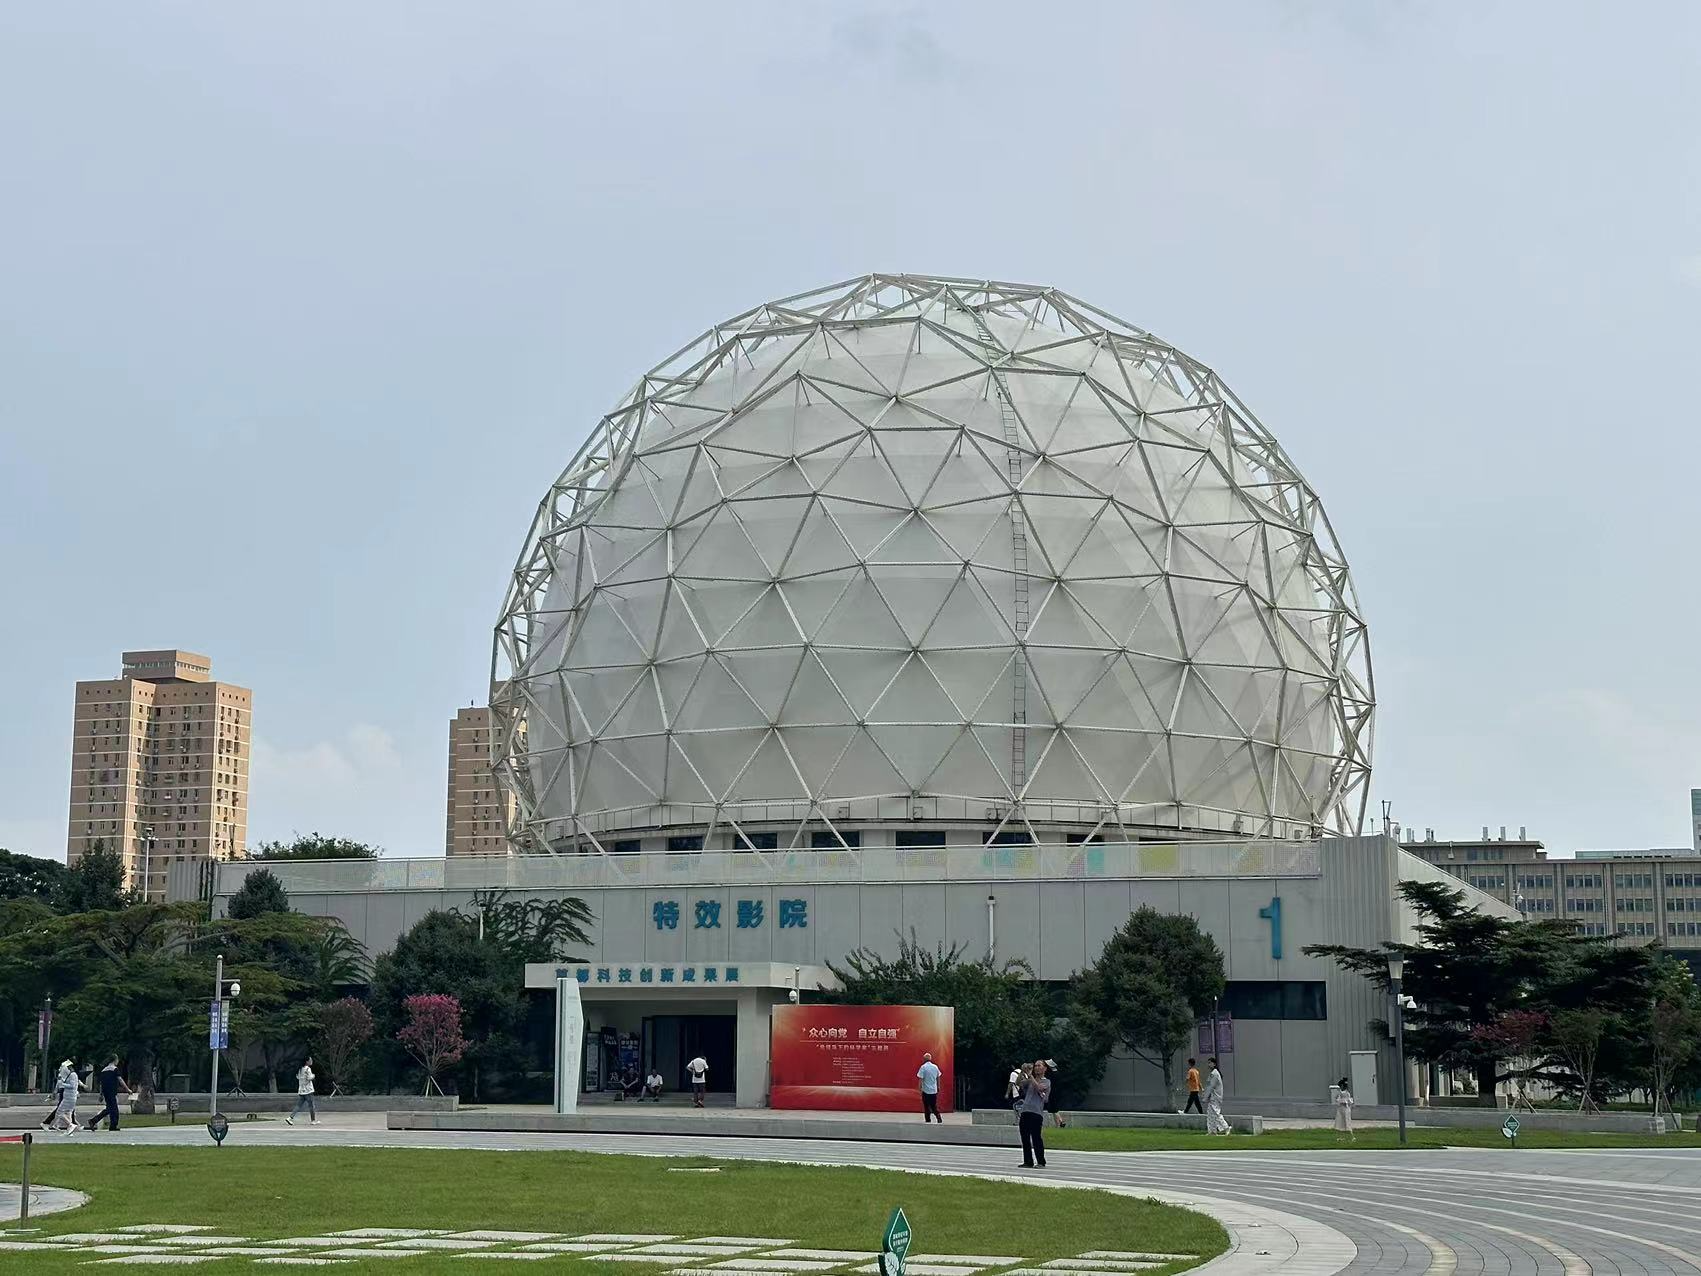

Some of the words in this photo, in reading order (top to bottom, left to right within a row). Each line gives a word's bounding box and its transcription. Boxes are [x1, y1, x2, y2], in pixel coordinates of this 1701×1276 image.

[653, 899, 807, 930] 特效影院
[1259, 897, 1282, 959] 1
[808, 1027, 848, 1039] 众心向党
[858, 1027, 897, 1040] 自立自强
